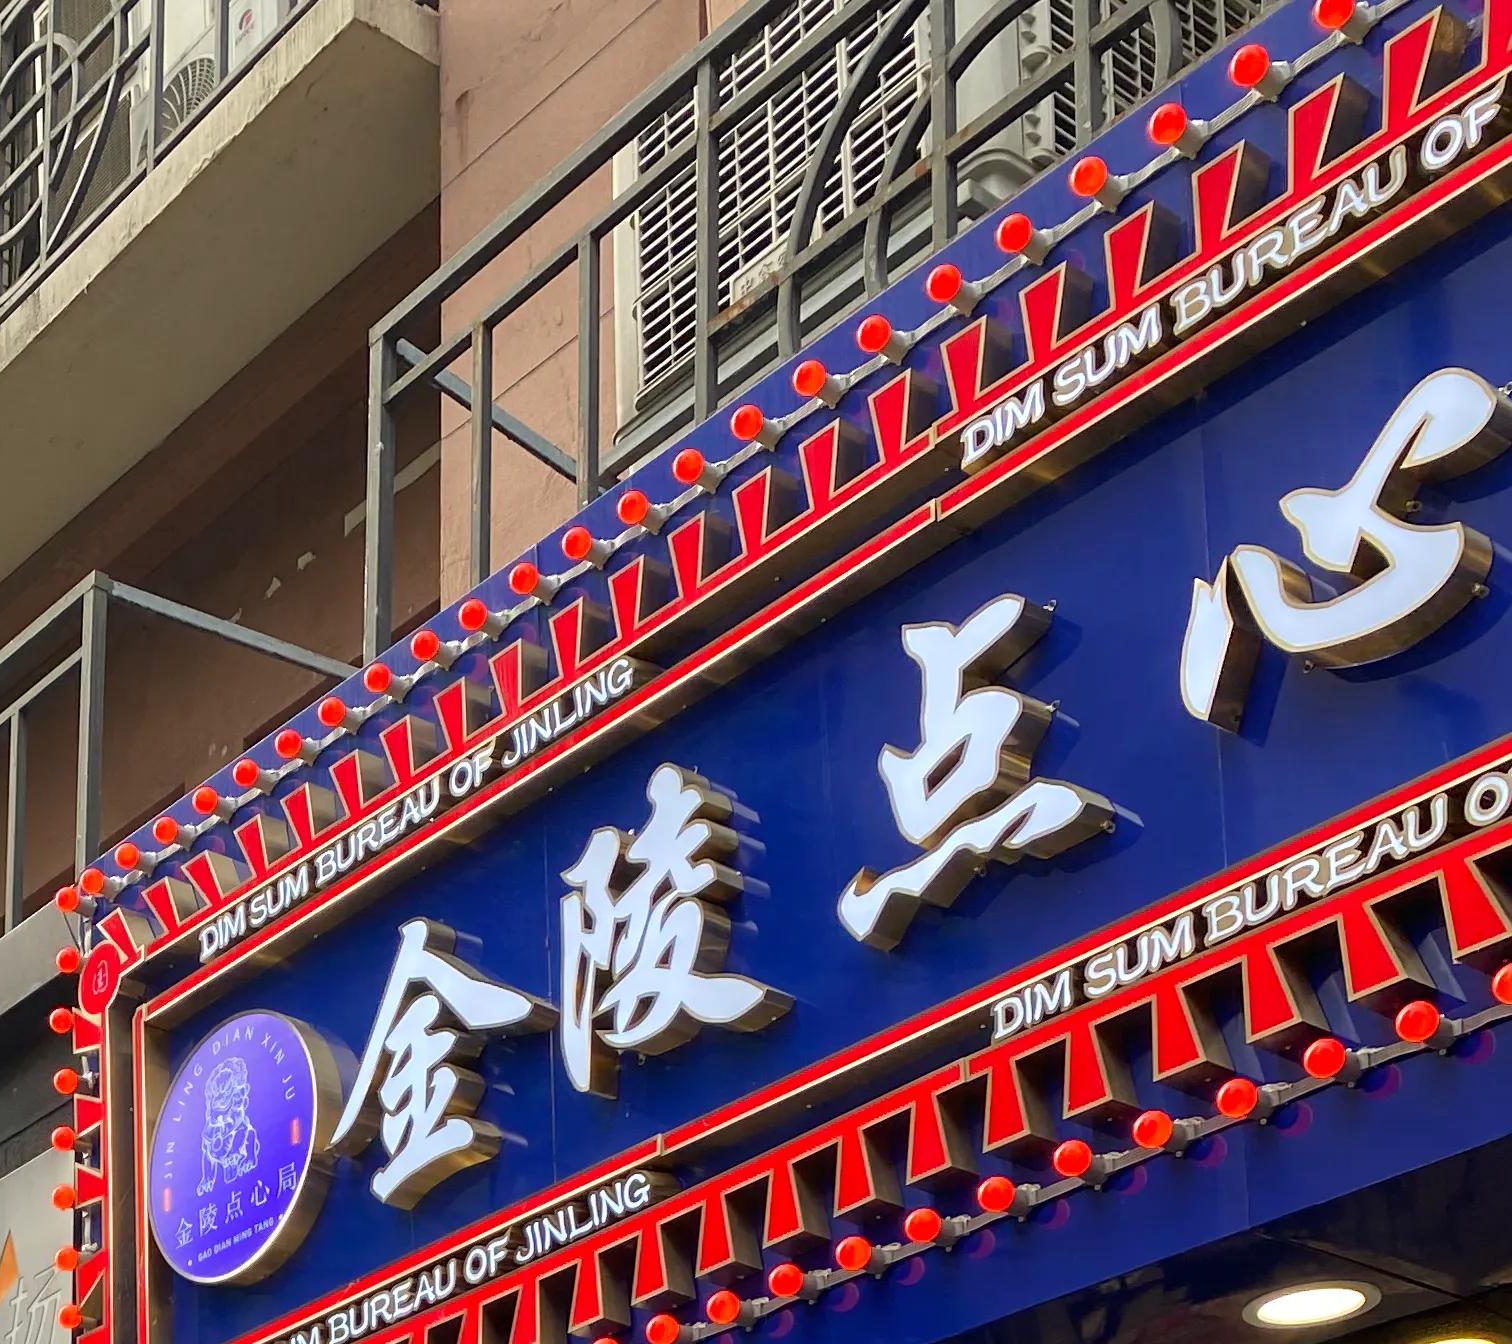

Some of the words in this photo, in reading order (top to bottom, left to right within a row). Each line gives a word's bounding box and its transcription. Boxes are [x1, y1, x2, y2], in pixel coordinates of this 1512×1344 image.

[960, 379, 1046, 467] DIM
[1052, 302, 1163, 407] SUM
[1172, 144, 1408, 337] BUREAU
[1420, 74, 1507, 170] OF
[199, 906, 248, 962] DIM
[250, 861, 309, 931] SUM
[315, 775, 441, 888] BUREAU
[448, 745, 496, 798] OF
[502, 657, 635, 770] JINLING
[991, 975, 1076, 1042] DIM
[1083, 917, 1196, 1000] SUM
[1203, 791, 1449, 946] BUREAU
[1463, 764, 1512, 828] O
[163, 1140, 177, 1180] JIN
[173, 1064, 205, 1124] LING
[211, 1024, 256, 1057] DIAN
[260, 1031, 287, 1066] XIN
[280, 1074, 297, 1102] JU
[174, 1160, 299, 1250] 金陵点心局
[463, 1232, 509, 1285] OF
[513, 1173, 650, 1264] JINLING
